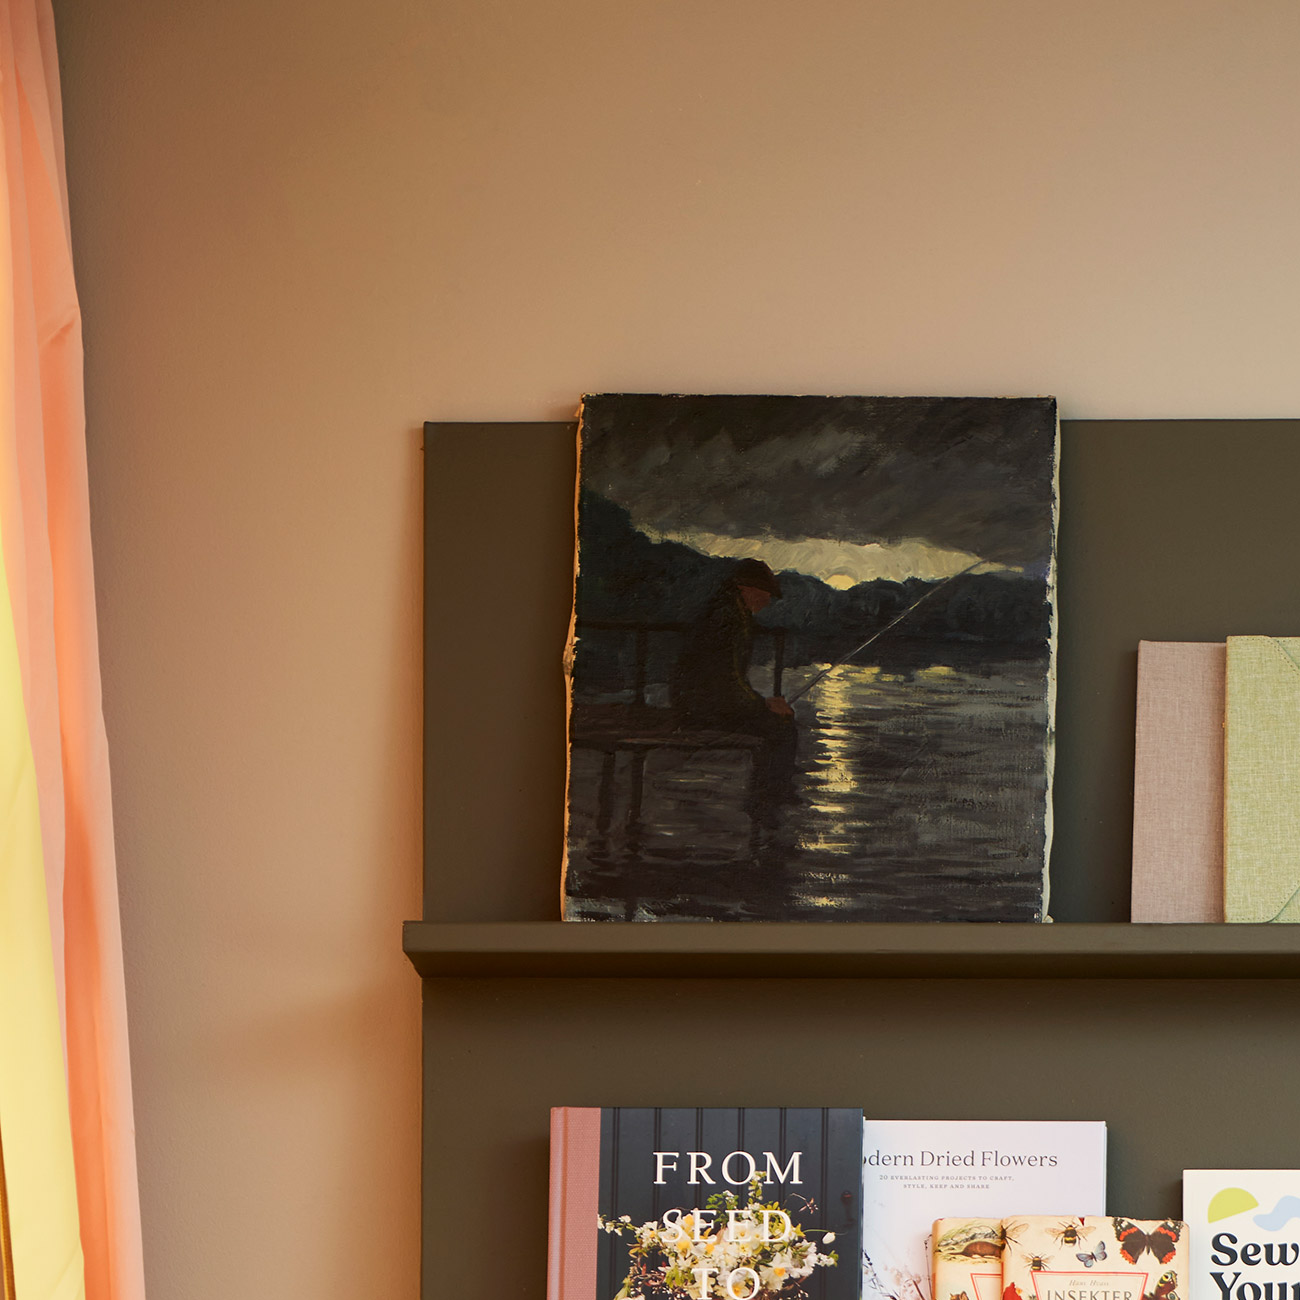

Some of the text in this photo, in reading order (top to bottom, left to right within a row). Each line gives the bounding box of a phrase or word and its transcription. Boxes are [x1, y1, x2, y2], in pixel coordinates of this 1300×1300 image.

[652, 1150, 803, 1186] FROM
[863, 1149, 1058, 1167] dern Dried Flowers
[662, 1208, 792, 1243] SEED
[1210, 1231, 1299, 1267] Sew
